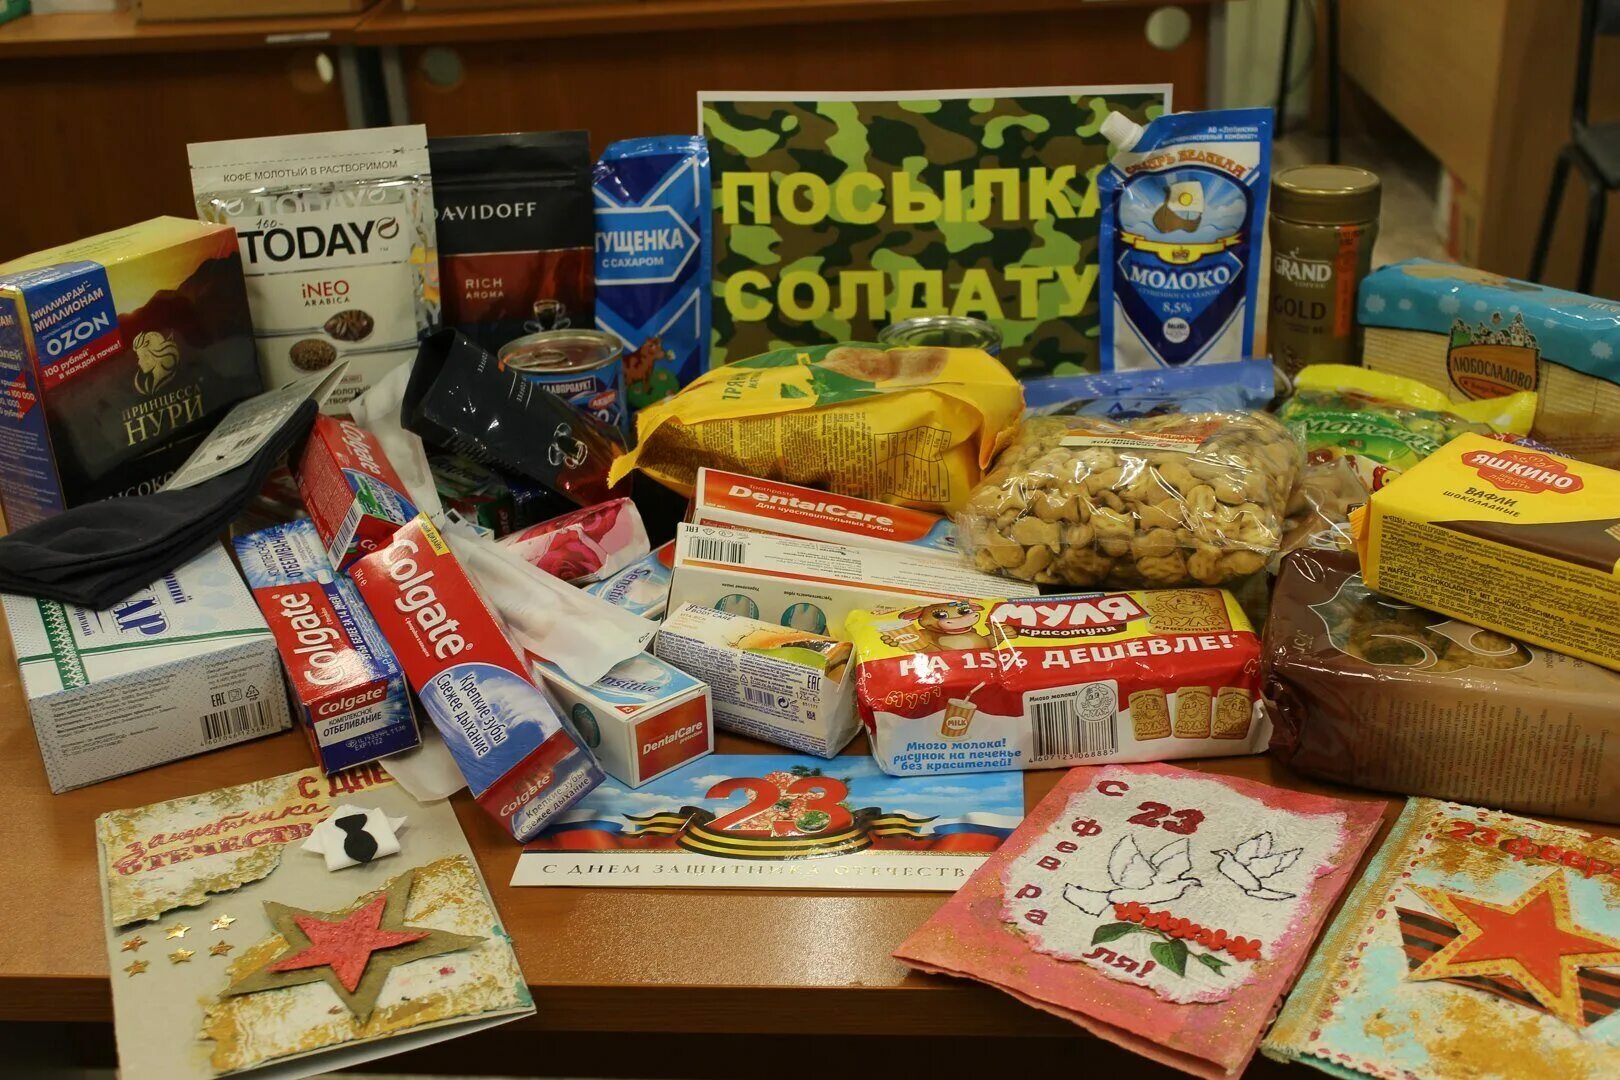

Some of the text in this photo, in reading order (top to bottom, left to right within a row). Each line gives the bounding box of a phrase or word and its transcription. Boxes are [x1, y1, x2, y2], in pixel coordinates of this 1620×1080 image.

[223, 160, 398, 183] КОФЕ МОЛОТЫЙ В РАСТВОРИМОМ
[237, 220, 375, 265] TODAY
[595, 228, 684, 255] ГУЩЕНКА
[602, 256, 664, 268] С САХАРОМ
[1274, 258, 1332, 285] GRAND
[302, 280, 350, 299] iNEO
[465, 278, 503, 289] RICH
[1130, 265, 1231, 290] МОЛОКО
[304, 297, 350, 307] ARABICA
[465, 291, 504, 300] AROMA
[723, 264, 1100, 322] СОЛДАТУ
[34, 288, 104, 333] МИЛЛИОНАМ
[1162, 301, 1192, 314] 8,5%
[1274, 299, 1327, 322] GOLD
[46, 311, 110, 357] OZON
[44, 364, 60, 378] 100
[59, 372, 65, 380] в
[66, 356, 96, 378] каждой
[122, 385, 201, 421] ПРИНЦЕССА
[123, 396, 205, 446] НУРИ
[339, 419, 383, 473] Colgate
[1471, 453, 1574, 489] ЯШКИНО
[728, 485, 894, 526] DentalCare
[1464, 485, 1519, 507] ВАФЛИ
[755, 502, 895, 533] Для чувствительных зубов
[382, 537, 472, 661] Colgate
[995, 594, 1143, 628] МУЛЯ
[1019, 624, 1118, 639] красотуля
[1149, 615, 1225, 627] МУЛЯ
[280, 592, 345, 686] Colgate
[900, 635, 1232, 678] НА 15% ДЕШЕВЛЕ!
[807, 675, 821, 691] EAC
[211, 691, 227, 707] EAC
[318, 687, 384, 716] Colgate
[459, 673, 507, 745] Крепкие зубы
[1029, 690, 1079, 703] Много молока!
[323, 711, 383, 737] ОТБЕЛИВАНИЕ
[329, 706, 373, 726] КОМПЛЕКСНОЕ
[436, 673, 490, 757] Свежее дыхание
[947, 717, 969, 729] MILK
[1080, 705, 1114, 718] МУЛЯ
[642, 720, 704, 756] DentalCare
[907, 738, 1007, 753] Много молока!
[894, 747, 1022, 765] рисунок на печенье
[901, 755, 1012, 771] без красителей!
[1078, 748, 1115, 759] 068885
[297, 766, 396, 799] С ДНЕ
[500, 773, 551, 818] Colgate
[526, 770, 586, 820] Крепкие зубы
[1097, 780, 1130, 797] С
[520, 777, 591, 834] Свежее дыхание
[704, 777, 855, 836] 23
[1126, 802, 1206, 835] 23
[1450, 820, 1501, 846] 23
[112, 819, 330, 878] ОТЕЧЕСТВ
[543, 863, 560, 875] С
[567, 863, 640, 876] ДНЕМ
[652, 862, 819, 876] ЗАЩИТНИКА
